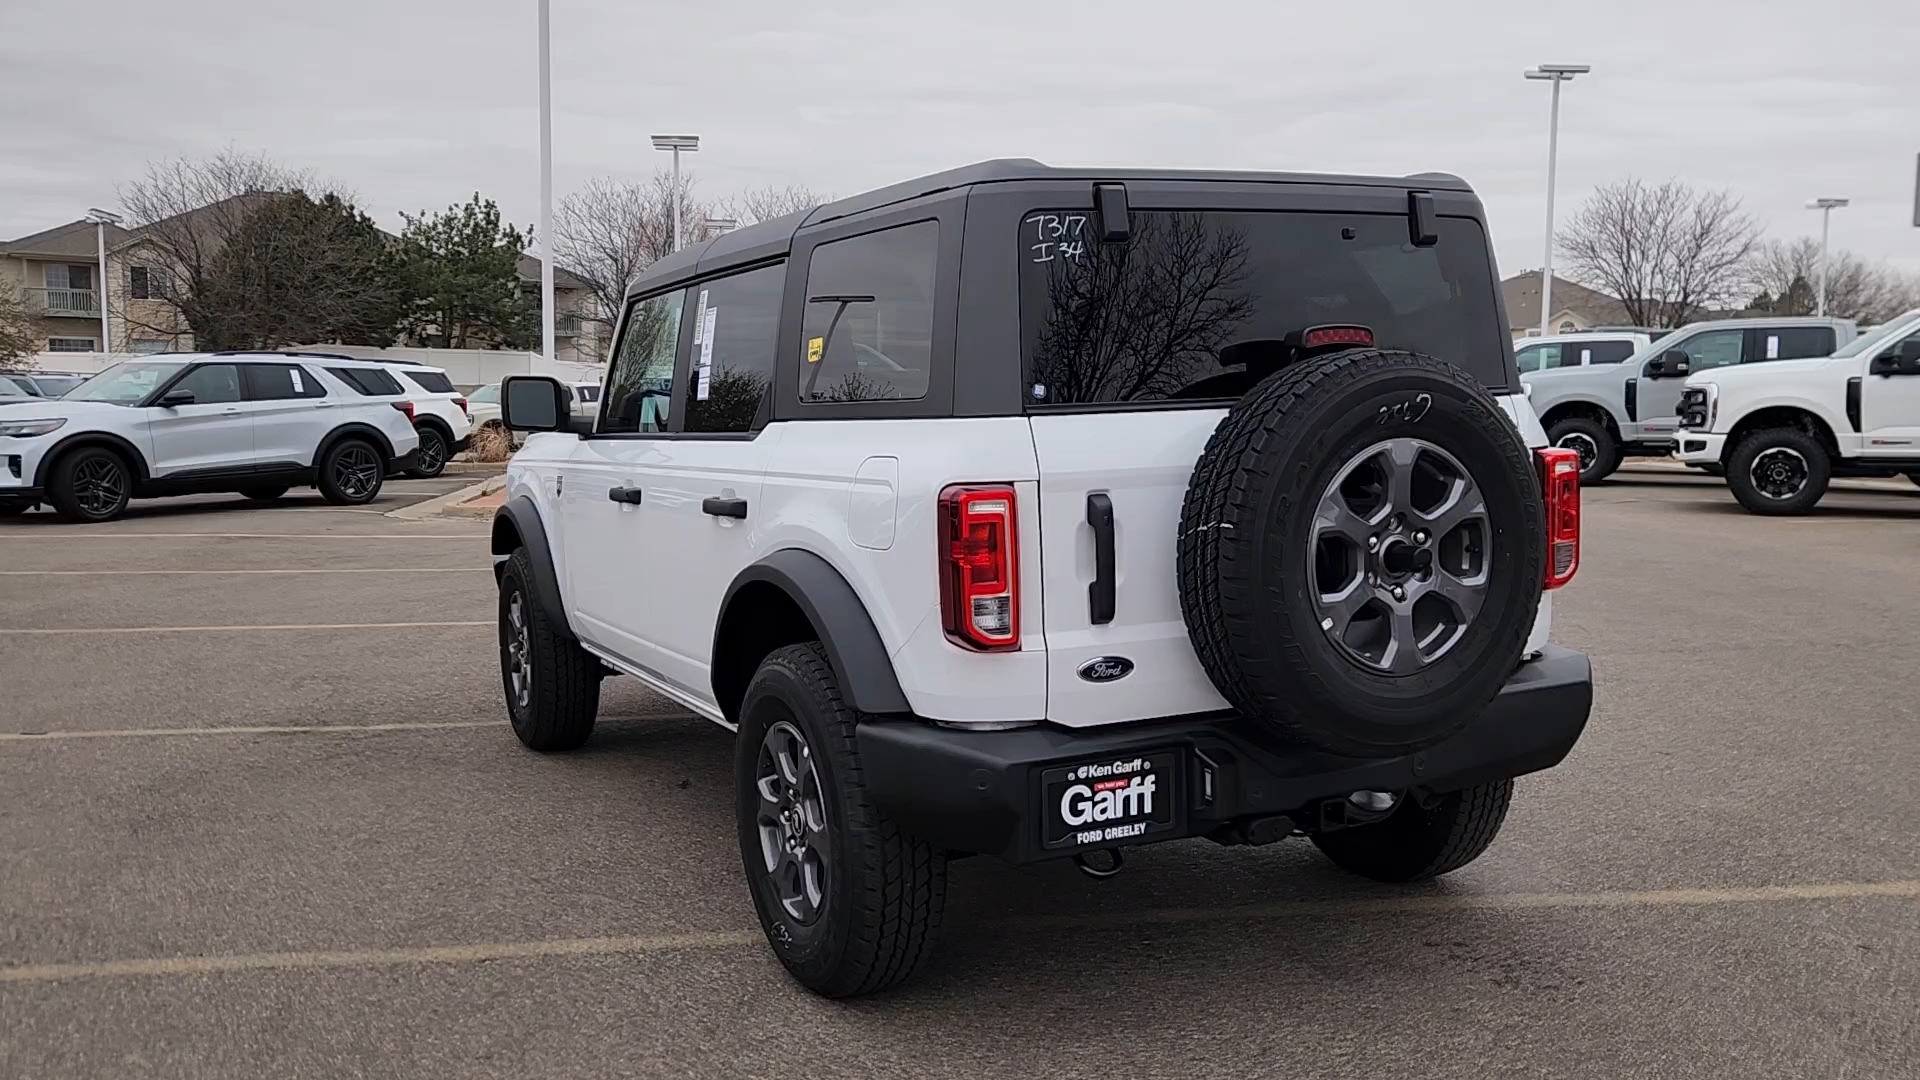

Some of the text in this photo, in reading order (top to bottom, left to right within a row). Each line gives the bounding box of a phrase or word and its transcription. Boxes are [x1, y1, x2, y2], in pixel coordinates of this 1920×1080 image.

[1091, 662, 1122, 678] Ford
[1088, 758, 1142, 778] Ken Garff
[1061, 774, 1156, 826] Garff
[1077, 822, 1146, 844] FORD GREELEY
